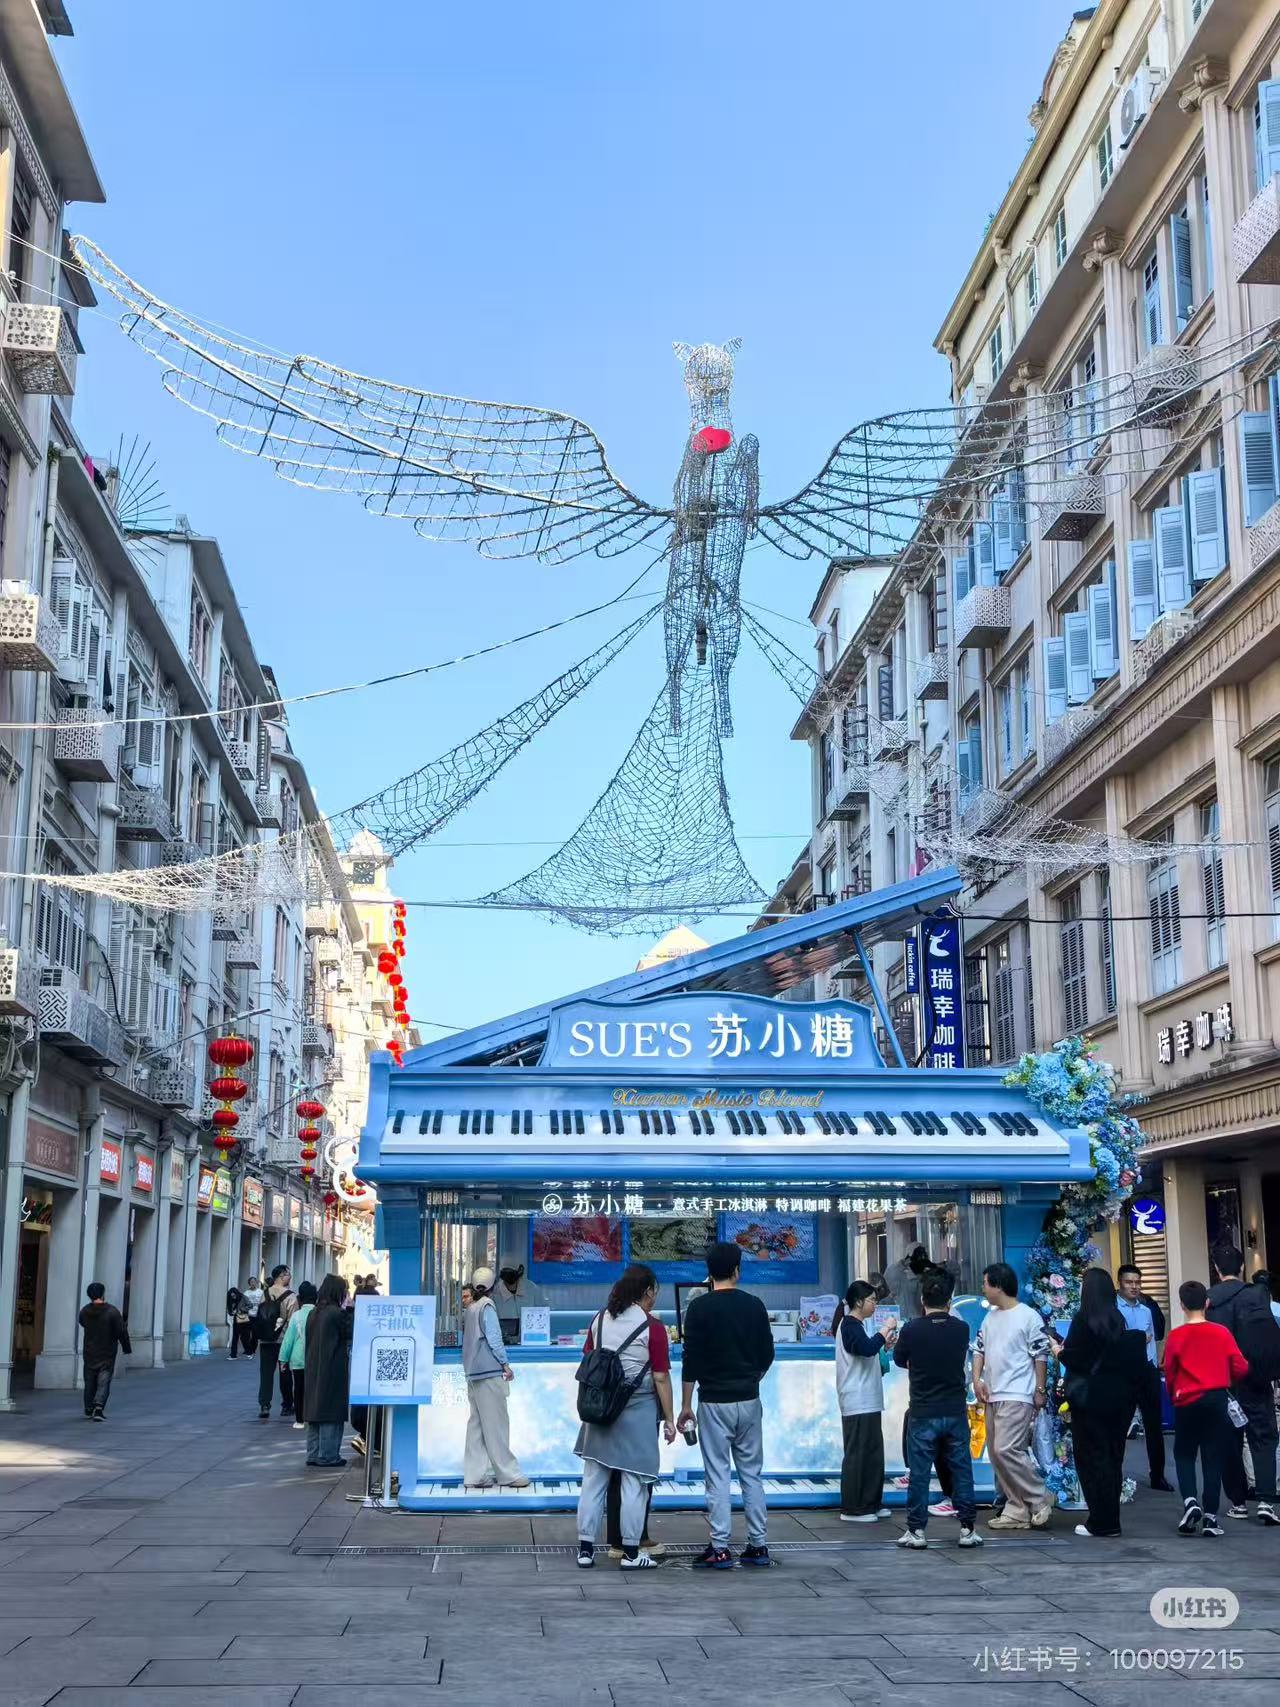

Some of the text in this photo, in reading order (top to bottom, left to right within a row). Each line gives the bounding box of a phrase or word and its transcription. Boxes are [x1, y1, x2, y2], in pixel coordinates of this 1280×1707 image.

[908, 964, 917, 987] coffee
[569, 1012, 854, 1059] SUE'S 苏小糖
[692, 1088, 754, 1109] Music
[757, 1089, 825, 1108] Island
[571, 1193, 908, 1216] 苏小糖 意式手工冰淇淋 特调咖啡 福建花果茶
[375, 1317, 417, 1331] 不排队
